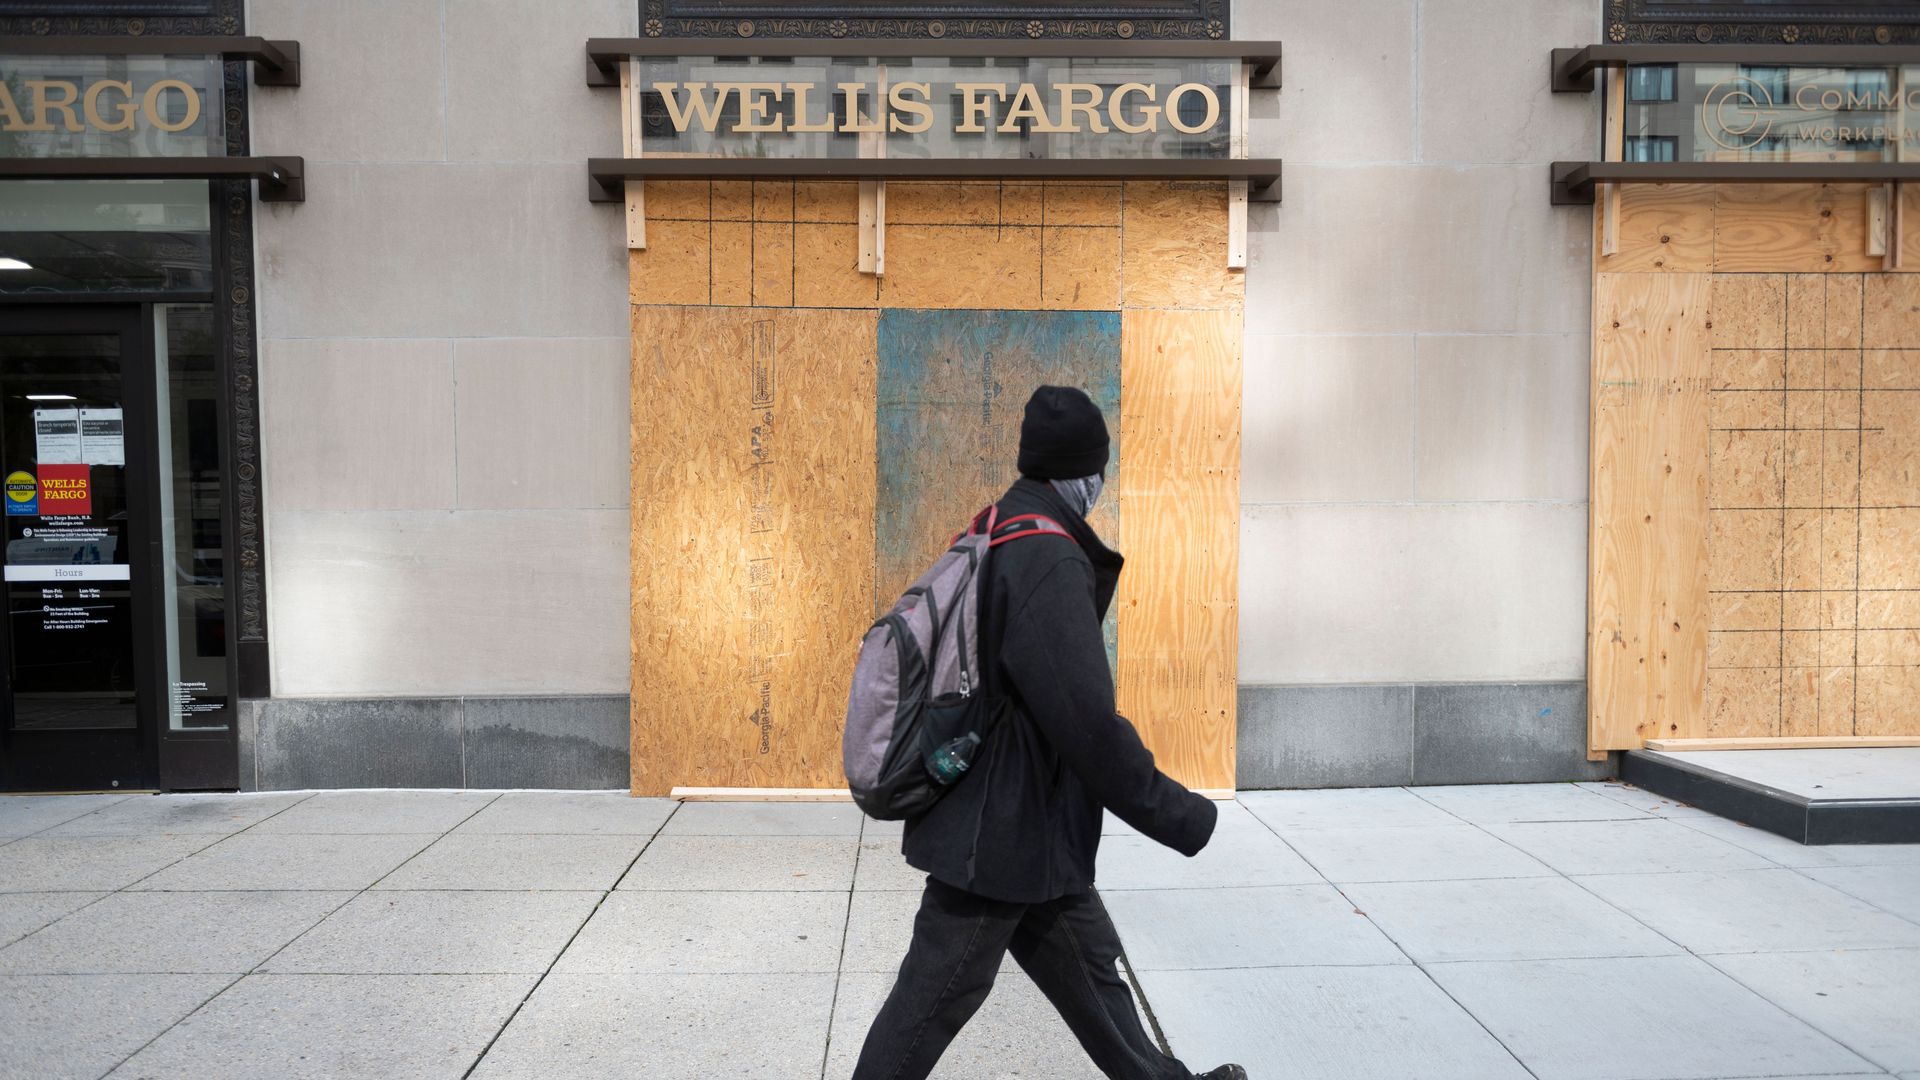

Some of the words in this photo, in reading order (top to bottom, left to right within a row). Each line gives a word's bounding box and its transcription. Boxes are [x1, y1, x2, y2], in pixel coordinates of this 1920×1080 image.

[653, 82, 934, 133] WELLS
[954, 82, 1220, 134] FARGO
[982, 351, 993, 426] Georgia-Pacific
[751, 426, 761, 460] APA
[42, 479, 87, 488] WELLS
[44, 490, 87, 499] FARGO
[55, 568, 83, 577] Hours
[760, 680, 771, 754] Georgia-Pacific
